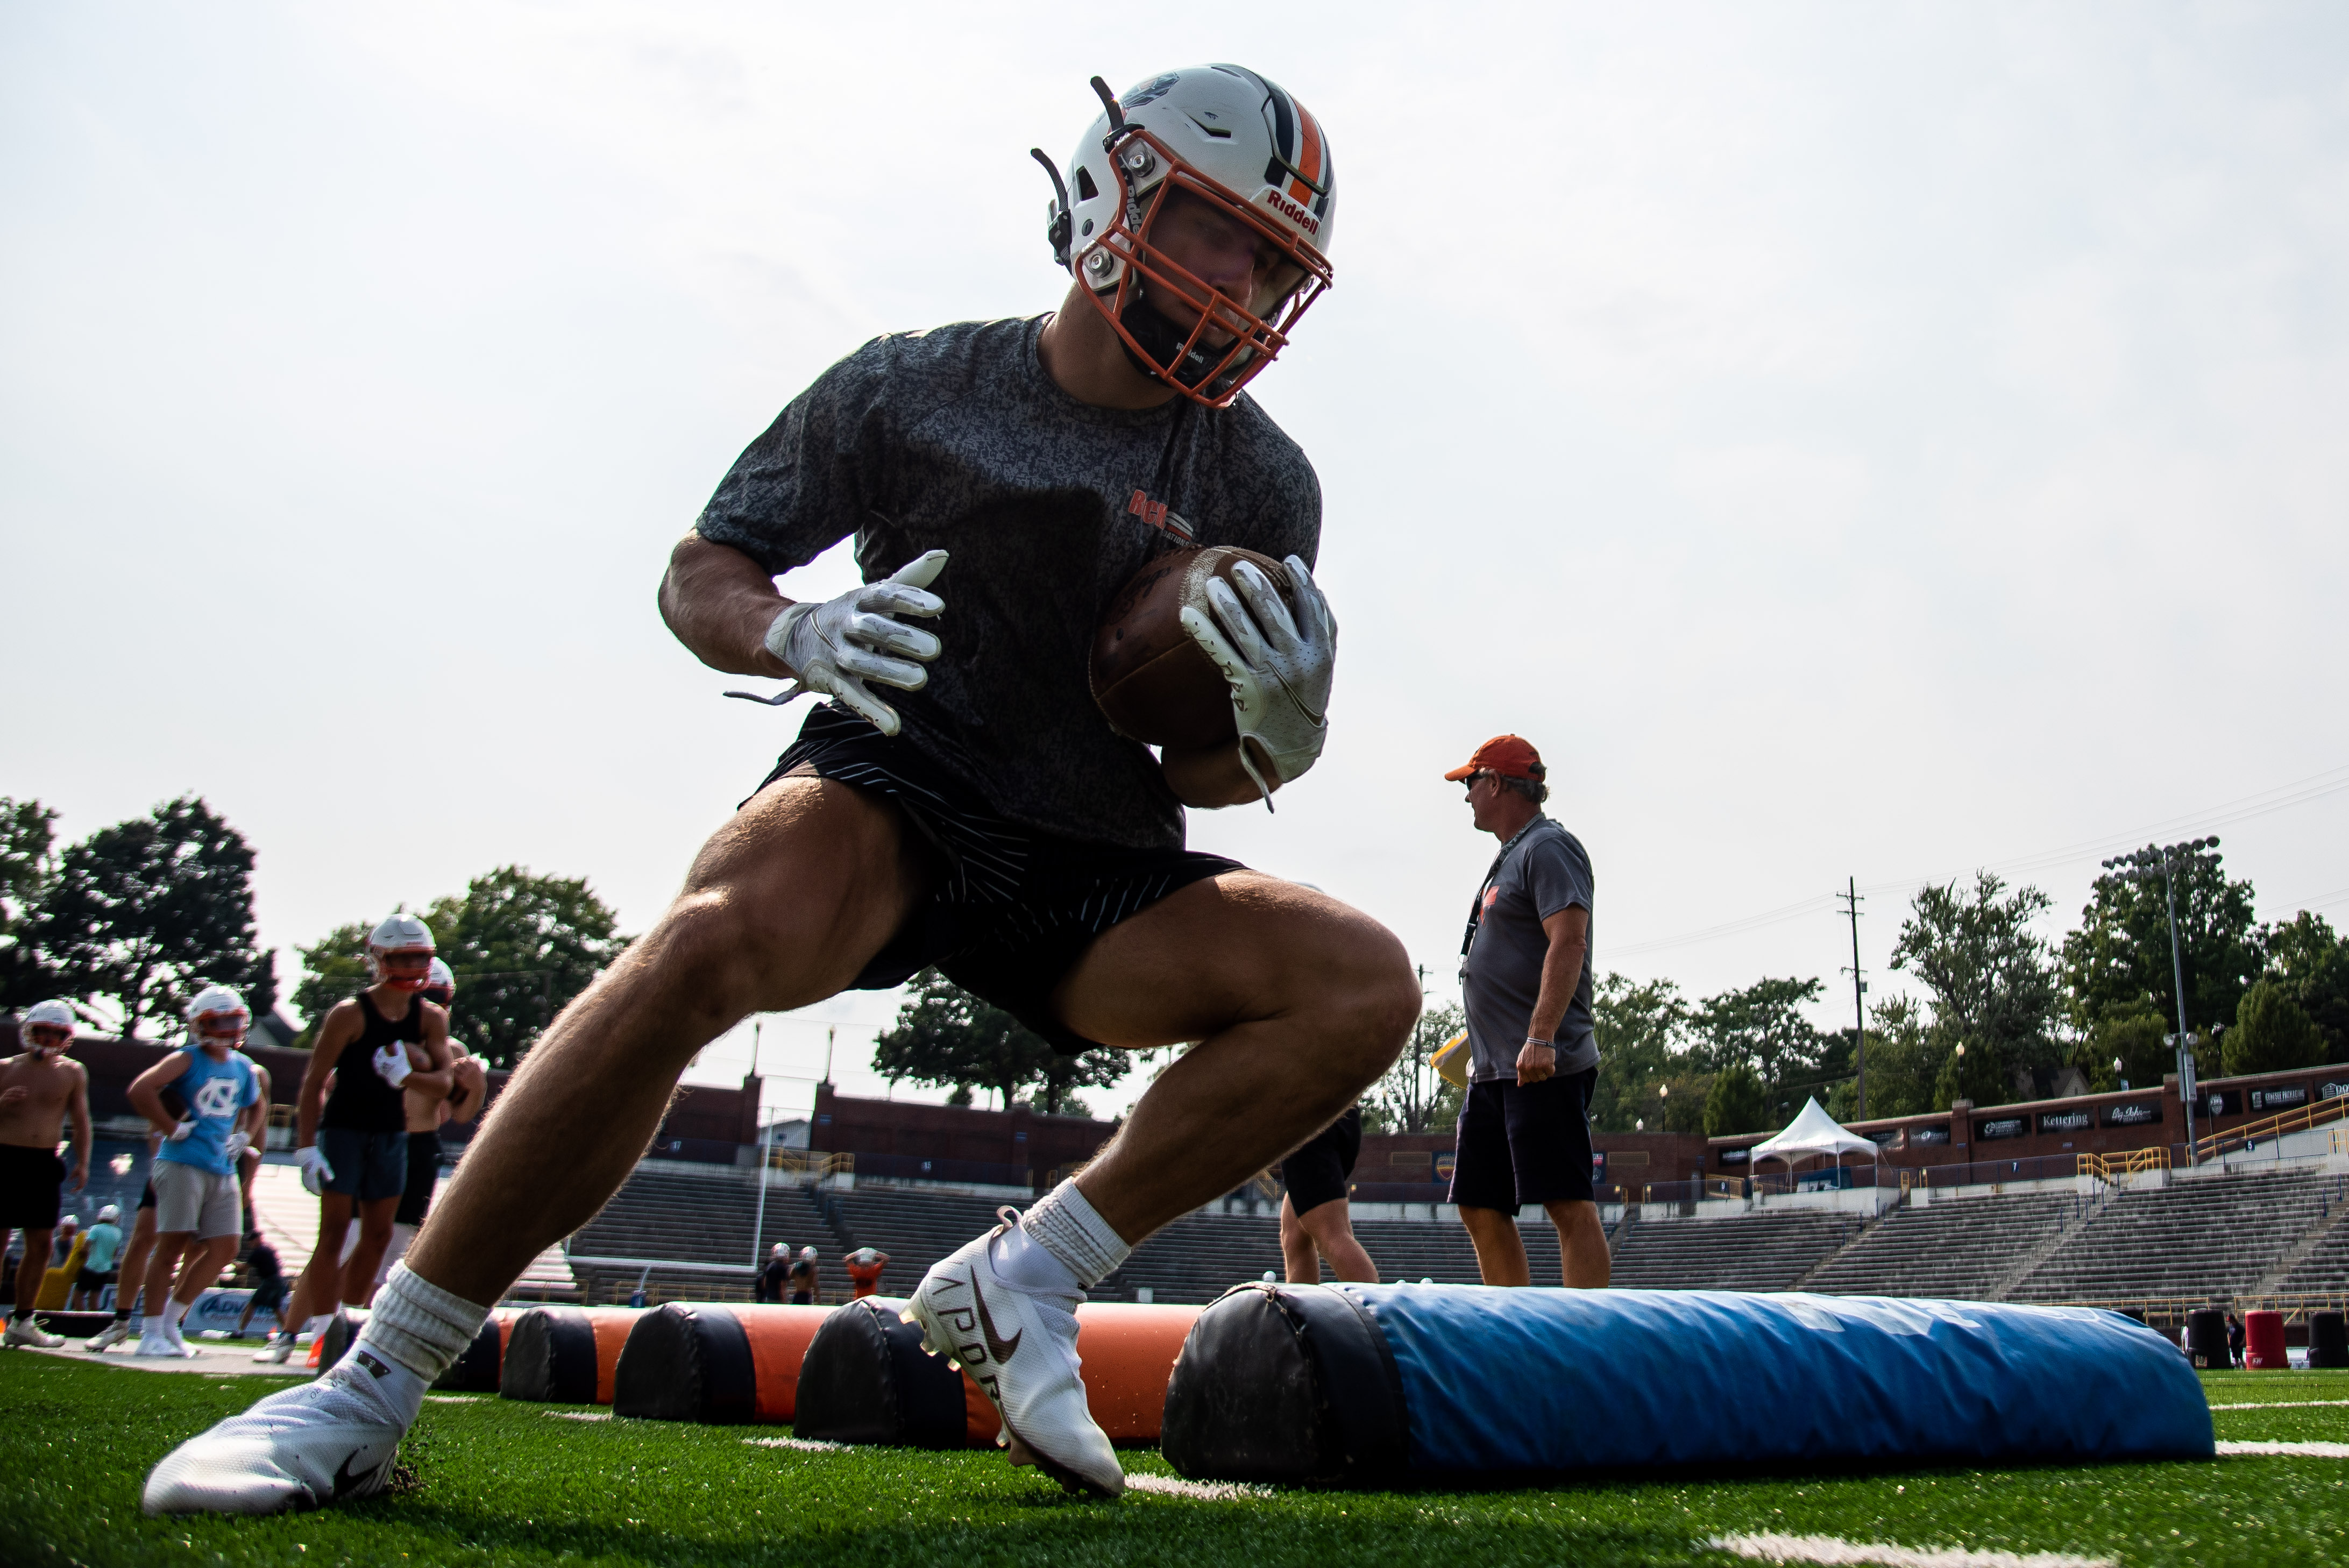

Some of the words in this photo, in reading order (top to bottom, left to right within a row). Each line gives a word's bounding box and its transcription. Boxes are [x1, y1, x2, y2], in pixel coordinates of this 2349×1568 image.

[1267, 189, 1319, 235] Riddell
[1176, 342, 1204, 364] Rddell
[2043, 1112, 2088, 1127] Kettering
